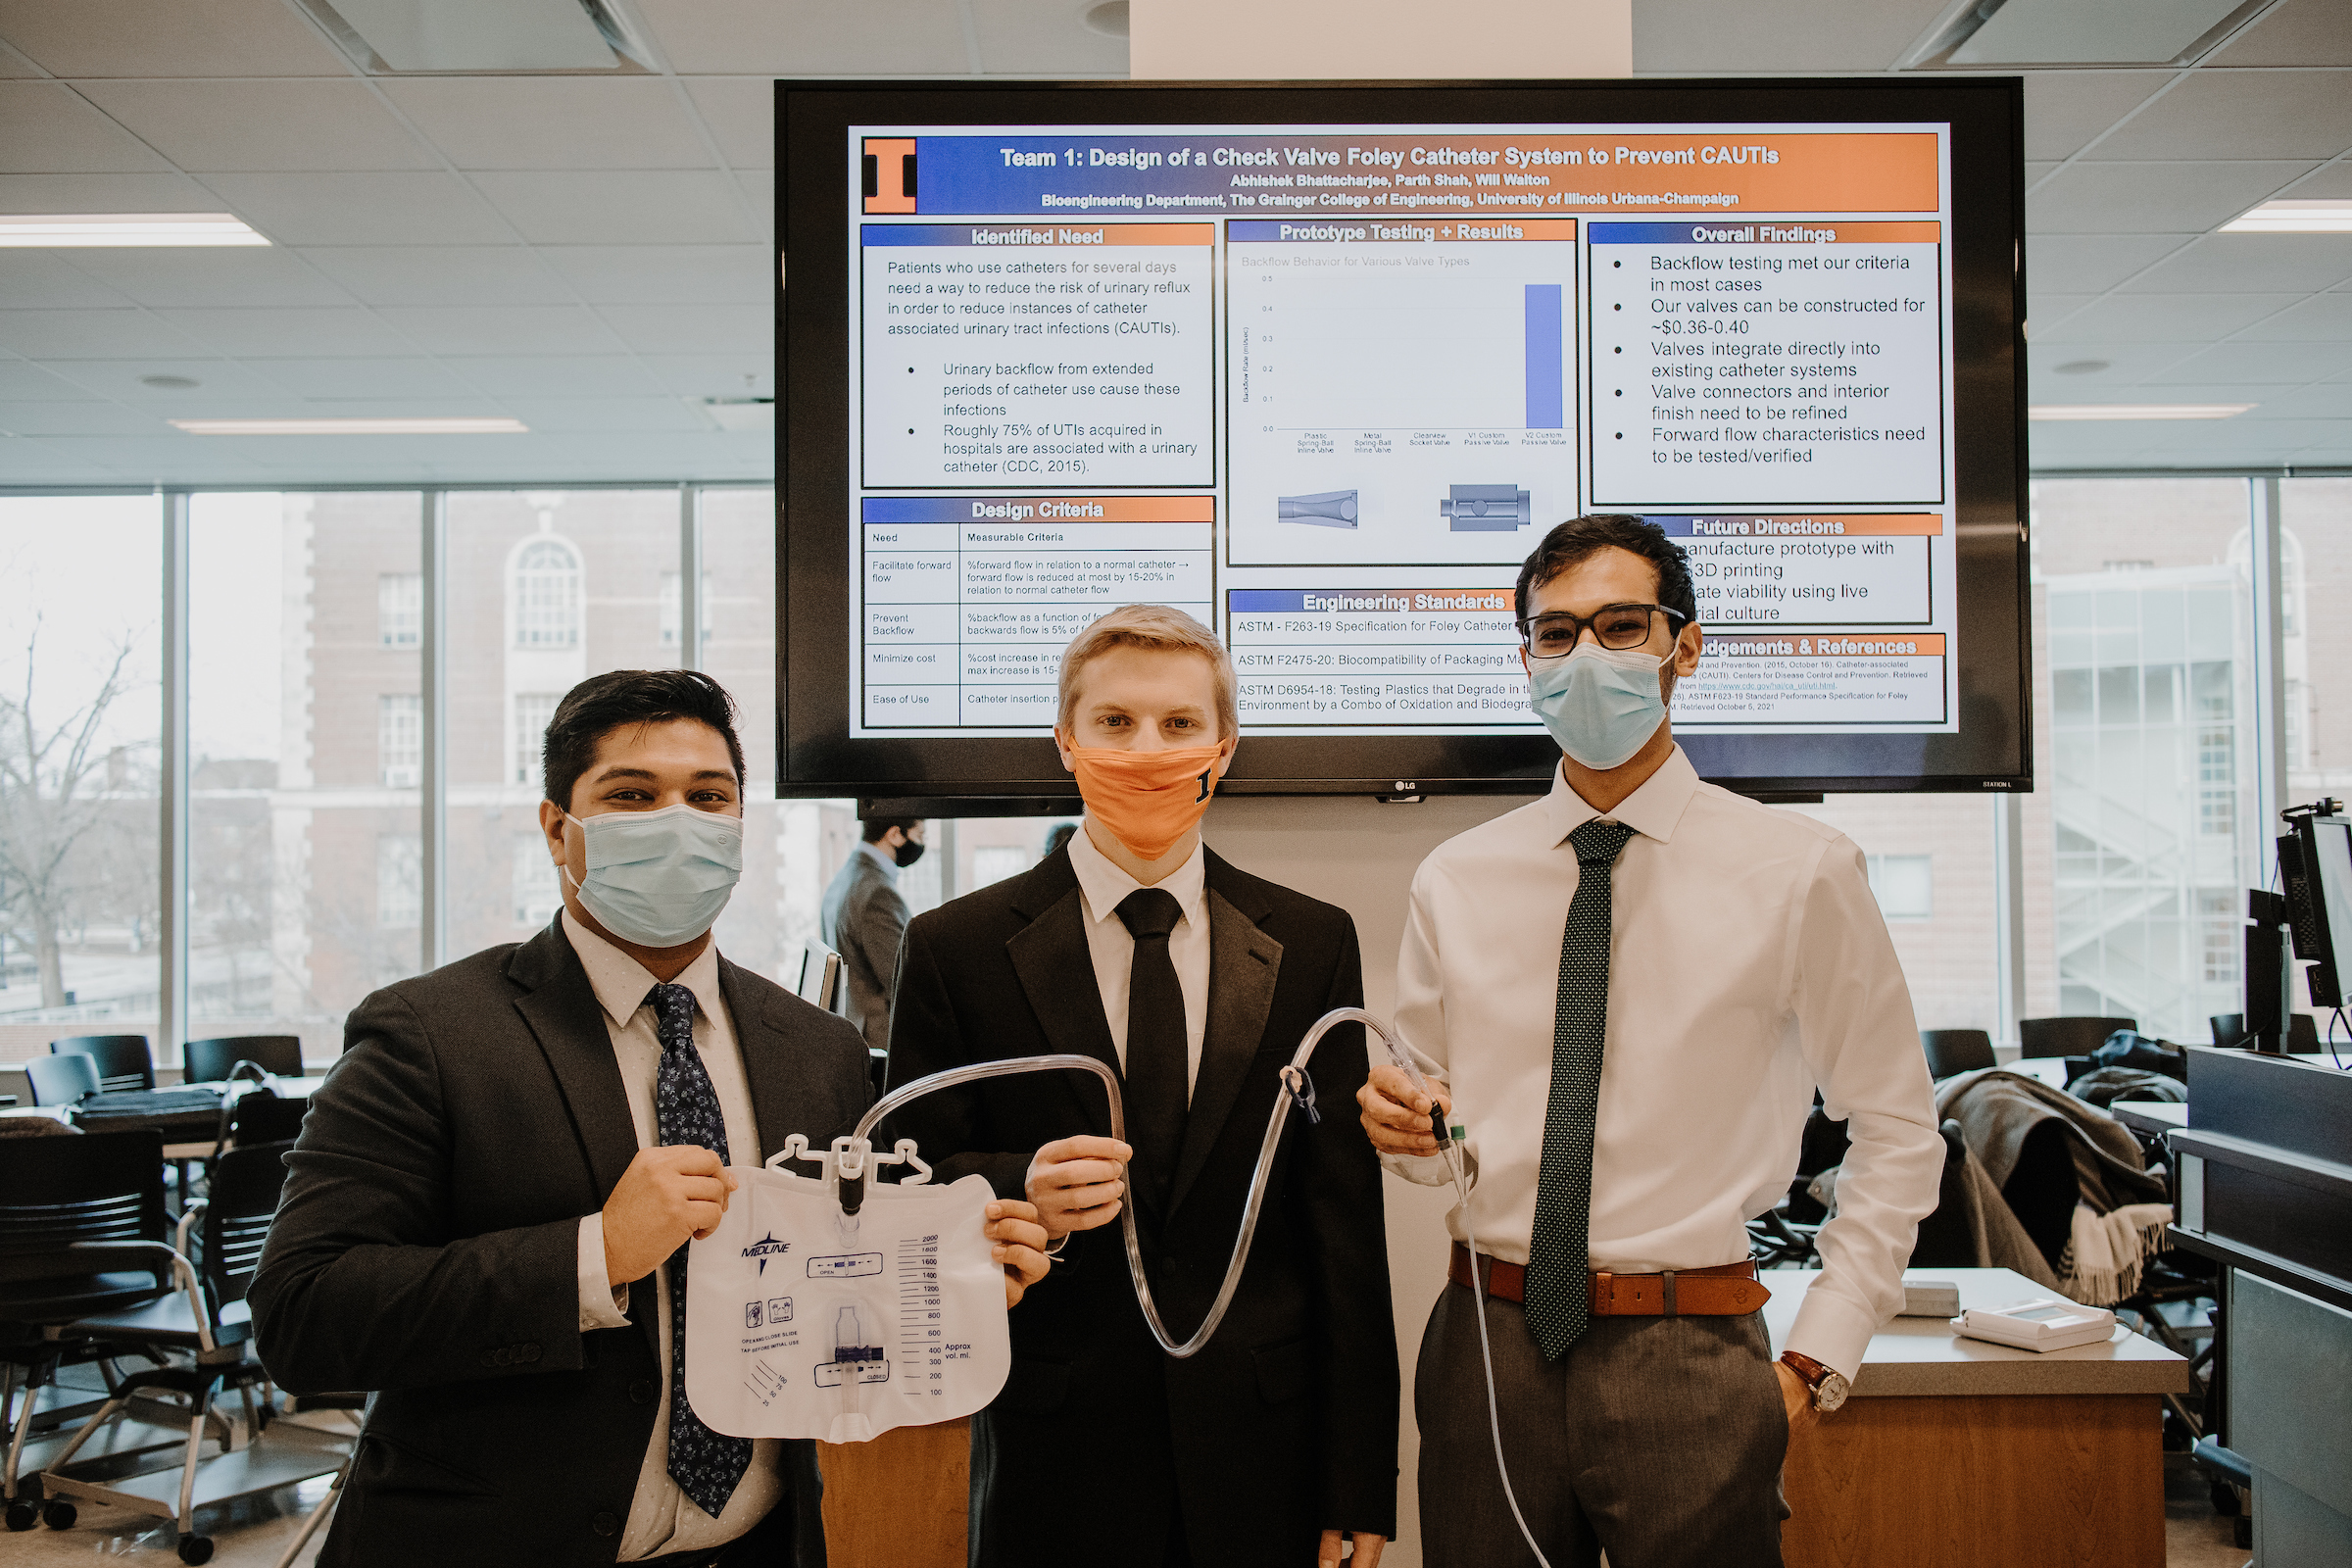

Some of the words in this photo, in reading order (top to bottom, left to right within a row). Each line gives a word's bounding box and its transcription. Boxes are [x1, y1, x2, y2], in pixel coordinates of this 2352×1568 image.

[1001, 149, 1055, 166] Team
[1064, 149, 1082, 166] 1:
[1090, 149, 1161, 170] Design
[1168, 149, 1190, 166] of
[1196, 153, 1206, 165] a
[1213, 148, 1278, 165] Check
[1284, 148, 1340, 165] Valve
[1348, 148, 1404, 169] Foley
[1411, 147, 1499, 165] Catheter
[1505, 147, 1582, 169] System
[1588, 148, 1608, 164] to
[1616, 147, 1694, 164] Prevent
[1701, 147, 1779, 164] CAUTIs
[1231, 174, 1294, 186] Abhishek
[1298, 174, 1392, 188] Bhattacharjee,
[1396, 174, 1431, 185] Parth
[1435, 174, 1472, 187] Shah,
[1476, 174, 1499, 185] Will
[1503, 174, 1549, 185] Walton
[1043, 194, 1142, 208] Bioengineering
[1147, 194, 1226, 208] Department,
[1230, 194, 1254, 205] The
[1259, 194, 1317, 208] Grainger
[1320, 194, 1370, 208] College
[1374, 194, 1388, 205] of
[1391, 193, 1473, 208] Engineering,
[1478, 193, 1544, 207] University
[1548, 193, 1561, 204] of
[1564, 193, 1608, 204] Illinois
[1612, 192, 1739, 206] Urbana-Champaign
[972, 229, 1053, 243] Identified
[1059, 229, 1102, 243] Need
[1281, 225, 1365, 242] Prototype
[1371, 224, 1435, 242] Testing
[1442, 226, 1452, 242] +
[1455, 223, 1524, 242] Results
[1693, 227, 1754, 241] Overall
[1760, 227, 1836, 243] Findings
[889, 262, 941, 273] Patients
[946, 262, 973, 273] who
[1006, 262, 1066, 272] catheters
[1072, 262, 1089, 272] for
[1094, 262, 1140, 272] several
[1146, 262, 1176, 275] days
[1243, 257, 1290, 266] Backflow
[1294, 257, 1340, 266] Behavior
[1345, 257, 1357, 266] for
[1362, 257, 1401, 266] Various
[1405, 257, 1434, 266] Valve
[1439, 257, 1469, 268] Types
[1651, 256, 1723, 270] Backflow
[1730, 256, 1782, 272] testing
[1789, 257, 1818, 270] met
[1824, 259, 1850, 270] our
[1856, 255, 1909, 269] criteria
[889, 282, 920, 294] need
[925, 284, 933, 294] a
[938, 284, 964, 296] way
[968, 282, 980, 293] to
[986, 282, 1030, 293] reduce
[1035, 282, 1054, 293] the
[1060, 282, 1083, 293] risk
[1088, 281, 1100, 293] of
[1104, 282, 1150, 296] urinary
[1154, 281, 1190, 293] reflux
[1651, 278, 1664, 291] in
[1671, 278, 1709, 291] most
[1716, 280, 1762, 291] cases
[1652, 299, 1681, 313] Our
[1687, 299, 1738, 313] valves
[1744, 302, 1772, 313] can
[1780, 299, 1797, 312] be
[1804, 298, 1897, 312] constructed
[1904, 298, 1925, 312] for
[1651, 319, 1748, 335] ~$0.36-0.40
[973, 502, 1033, 520] Design
[1039, 502, 1103, 516] Criteria
[1693, 519, 1748, 534] Future
[1755, 519, 1844, 534] Directions
[1685, 541, 1774, 556] anufacture
[1782, 542, 1856, 559] prototype
[1862, 541, 1893, 555] with
[917, 561, 951, 569] forward
[1695, 564, 1717, 576] 3D
[1724, 563, 1782, 580] printing
[1727, 584, 1787, 602] viability
[1793, 584, 1835, 602] using
[1842, 584, 1868, 598] live
[1303, 594, 1409, 612] Engineering
[1415, 594, 1504, 609] Standards
[873, 613, 907, 622] Prevent
[1726, 606, 1780, 619] culture
[873, 626, 914, 635] Backflow
[1238, 621, 1273, 631] ASTM
[1286, 621, 1331, 631] F263-19
[1336, 621, 1406, 633] Specification
[1411, 621, 1425, 631] for
[1430, 621, 1460, 633] Foley
[1464, 620, 1512, 631] Catheter
[1799, 639, 1812, 655] &
[1818, 639, 1916, 654] References
[1239, 655, 1273, 664] ASTM
[1278, 655, 1334, 664] F2475-20:
[1339, 655, 1426, 666] Biocompatibility
[1431, 655, 1441, 664] of
[1445, 655, 1503, 666] Packaging
[873, 695, 896, 704] Ease
[900, 695, 908, 704] of
[911, 695, 929, 704] Use
[741, 1243, 791, 1257] MEDLINE
[778, 1375, 788, 1384] 100
